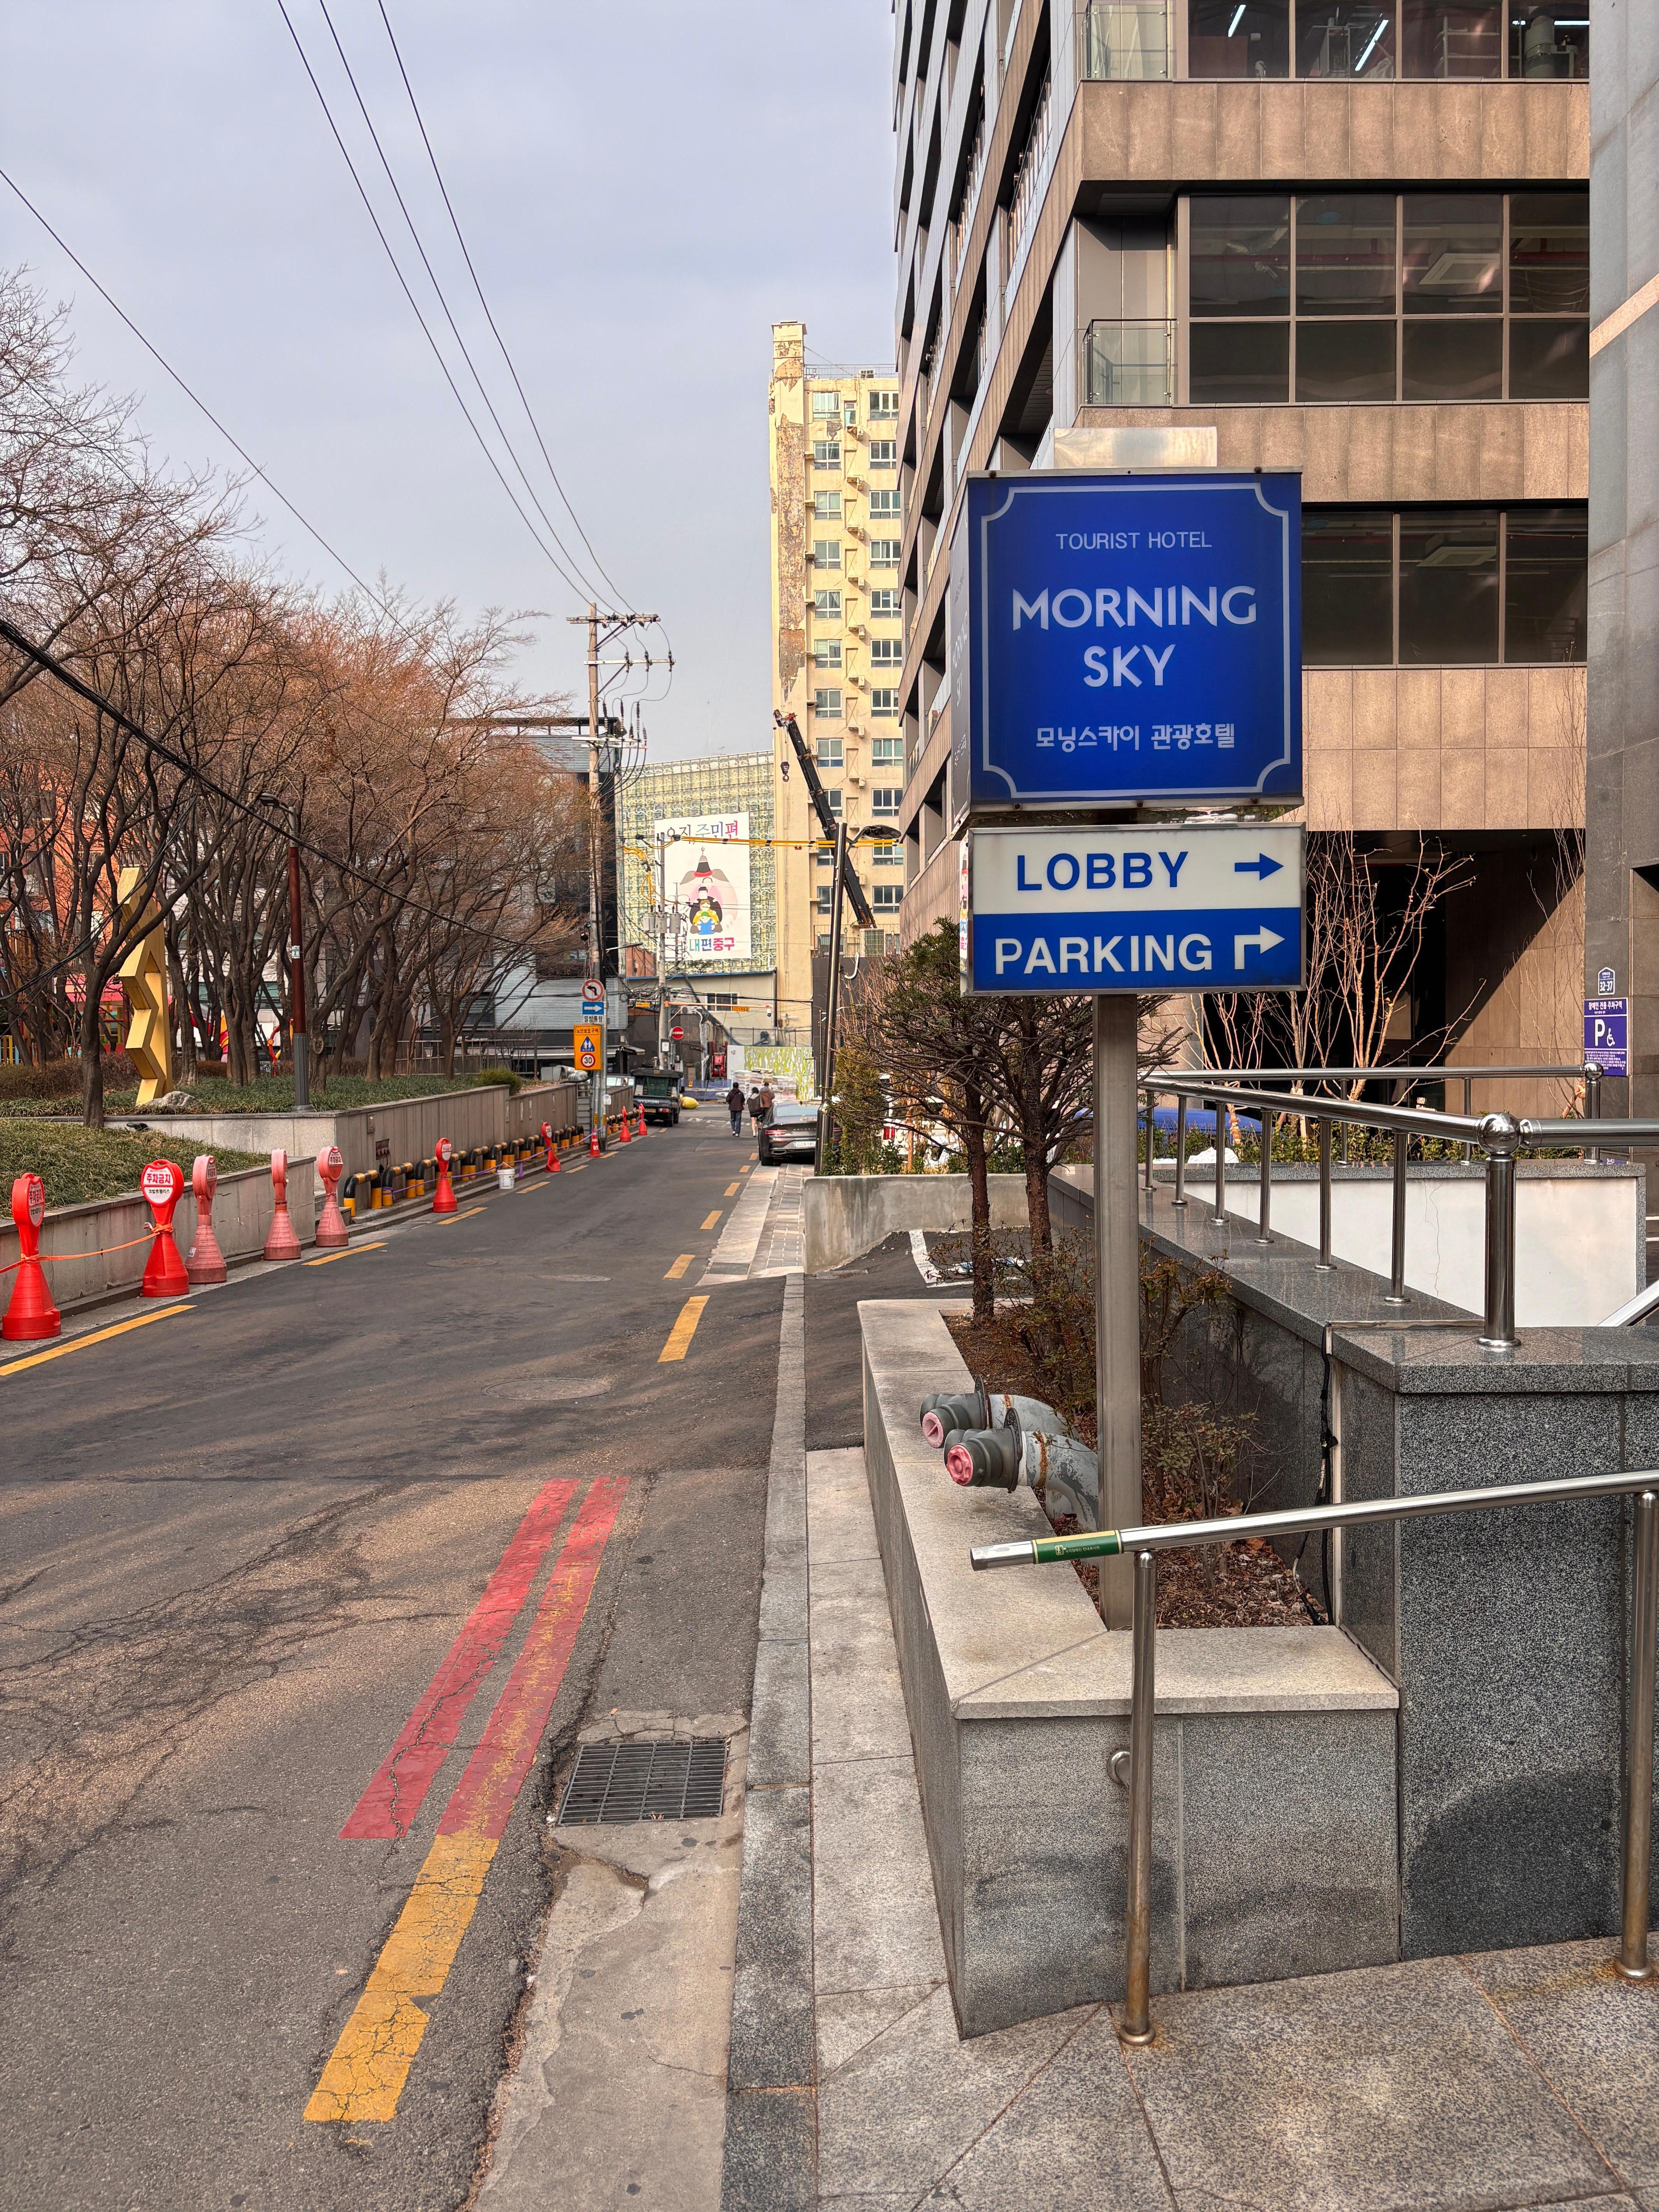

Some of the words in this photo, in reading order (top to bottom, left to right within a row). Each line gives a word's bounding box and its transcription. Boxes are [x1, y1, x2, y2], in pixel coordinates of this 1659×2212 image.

[1056, 533, 1140, 549] TOURIST
[1149, 532, 1212, 548] HOTEL
[1013, 586, 1256, 630] MORNING
[1084, 644, 1175, 687] SKY
[1036, 726, 1139, 752] 모닝스카이
[1151, 723, 1234, 749] 관광호텔
[1018, 852, 1188, 891] LOBBY
[996, 934, 1211, 974] PARKING
[1600, 981, 1613, 991] 32-37
[1589, 1002, 1599, 1010] 장애인
[1600, 1001, 1607, 1010] 전용
[1607, 1001, 1623, 1010] 주차구역
[1595, 1019, 1605, 1046] P
[147, 1174, 170, 1183] 주차금지
[29, 1189, 42, 1203] 주차금지
